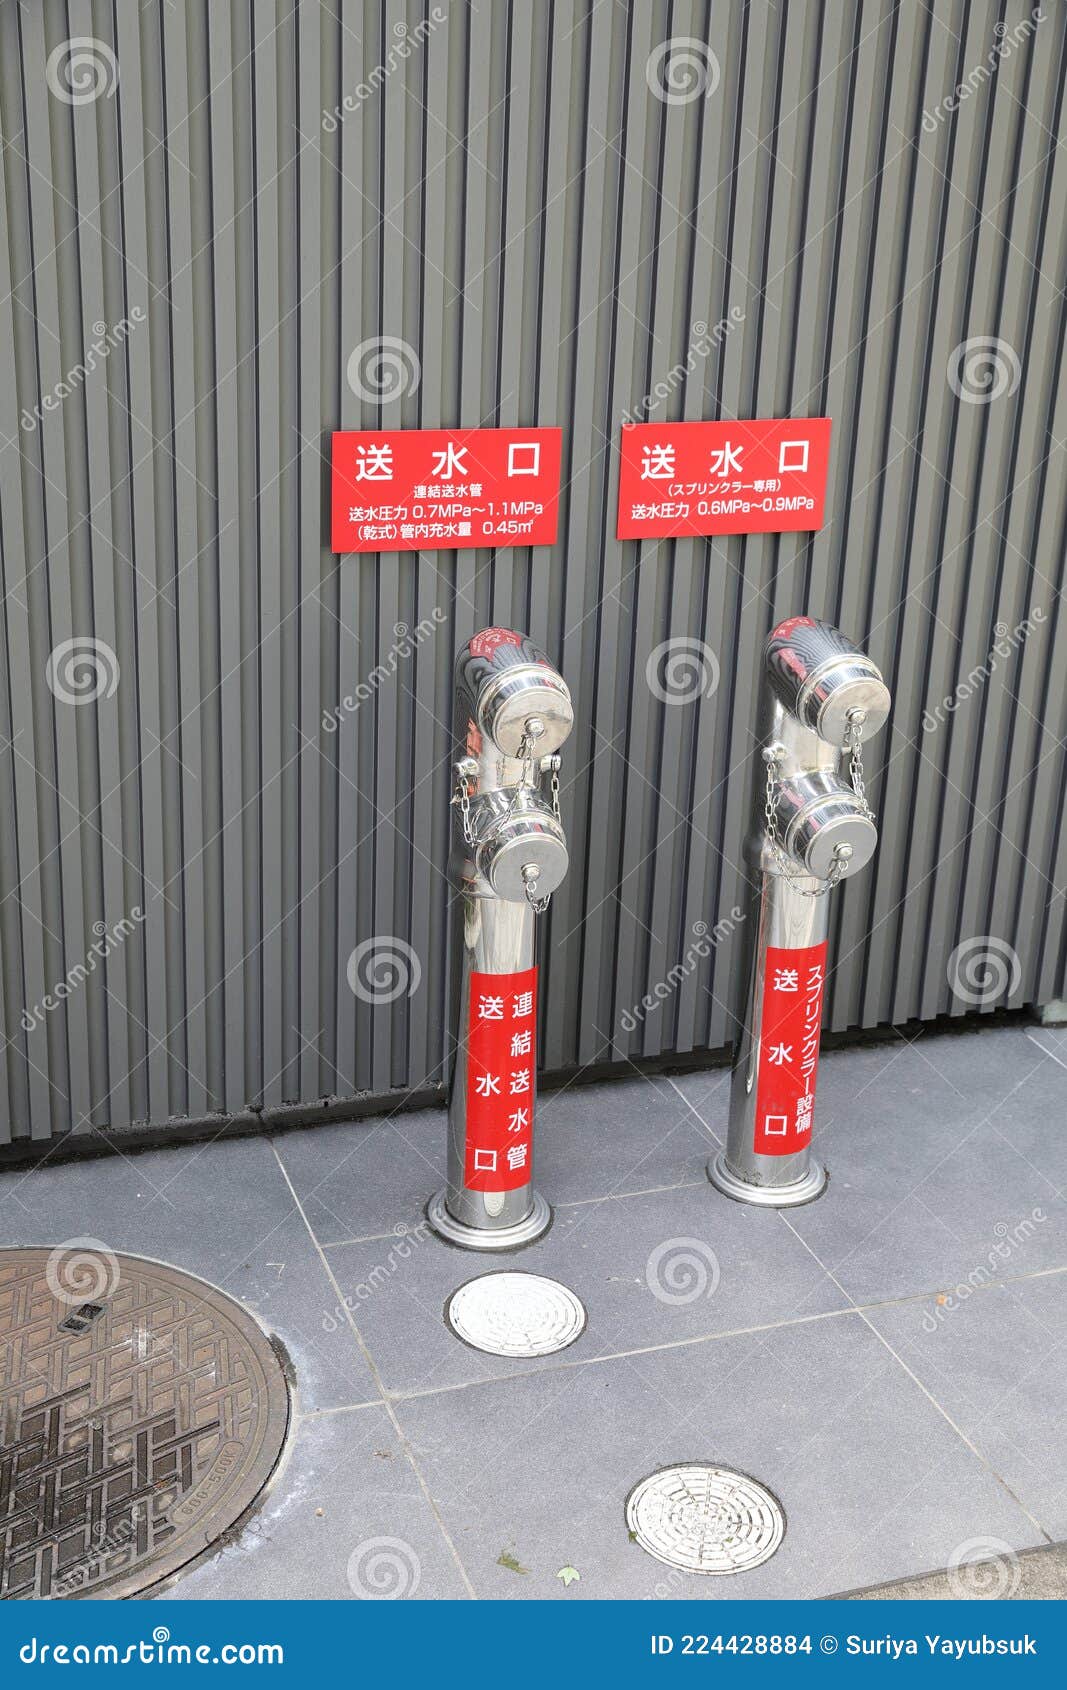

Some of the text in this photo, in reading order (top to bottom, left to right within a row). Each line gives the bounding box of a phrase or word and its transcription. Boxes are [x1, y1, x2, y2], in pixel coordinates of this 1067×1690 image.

[355, 442, 540, 481] 送水口
[641, 440, 809, 480] 送水口
[413, 483, 483, 499] 連結送水管
[631, 503, 689, 519] 送水圧力
[349, 506, 408, 522] 送水圧力
[764, 968, 798, 1136] 送水口
[795, 964, 823, 1134] スプリンクラー設備
[474, 995, 504, 1172] 送水口
[507, 991, 533, 1170] 連結送水管
